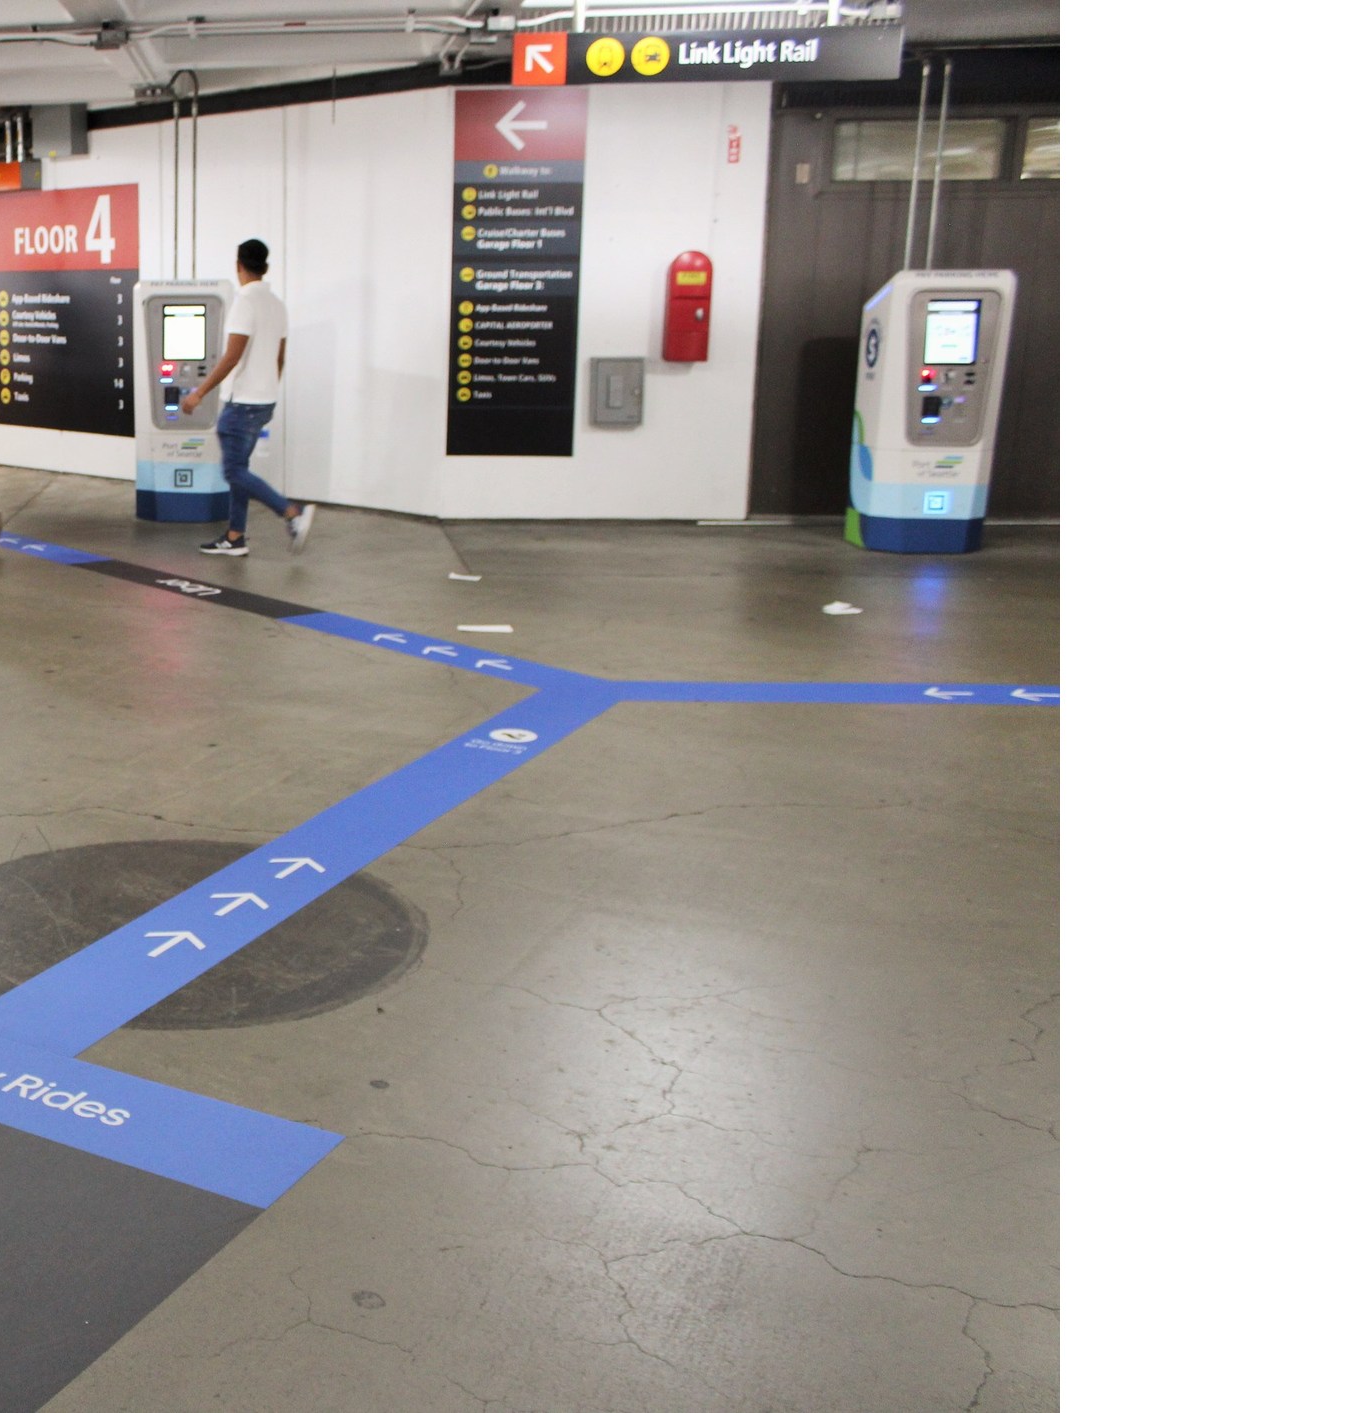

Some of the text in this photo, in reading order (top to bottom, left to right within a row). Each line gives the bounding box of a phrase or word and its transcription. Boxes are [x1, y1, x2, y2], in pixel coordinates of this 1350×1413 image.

[679, 38, 819, 69] Link Light Rail
[500, 166, 539, 177] Walkway
[478, 189, 539, 201] Link Light Rail
[478, 206, 504, 216] Public
[554, 206, 575, 216] Blvd
[14, 194, 116, 264] FLOOR 4
[476, 228, 566, 238] Cruise/Charter Buses
[476, 239, 510, 251] Garage
[511, 239, 535, 249] Floor
[476, 269, 573, 281] Ground Transportation
[475, 280, 509, 292] Garage
[509, 280, 534, 290] Floor
[117, 293, 123, 304] 3
[475, 303, 548, 313] App-Based Rideshare
[35, 310, 57, 320] Vehicles
[117, 315, 123, 326] 3
[51, 333, 67, 344] Vans
[474, 339, 537, 349] Courtesy Vehicles
[13, 352, 31, 363] Limos
[118, 357, 124, 368] 3
[473, 356, 540, 365] Door-to-Door Vans
[13, 372, 34, 385] Parking
[497, 373, 518, 382] Town
[14, 391, 29, 402] Taxis
[473, 390, 492, 399] Taxis
[118, 399, 124, 410] 3
[155, 578, 222, 596] Uber
[2, 1074, 132, 1128] Rides
